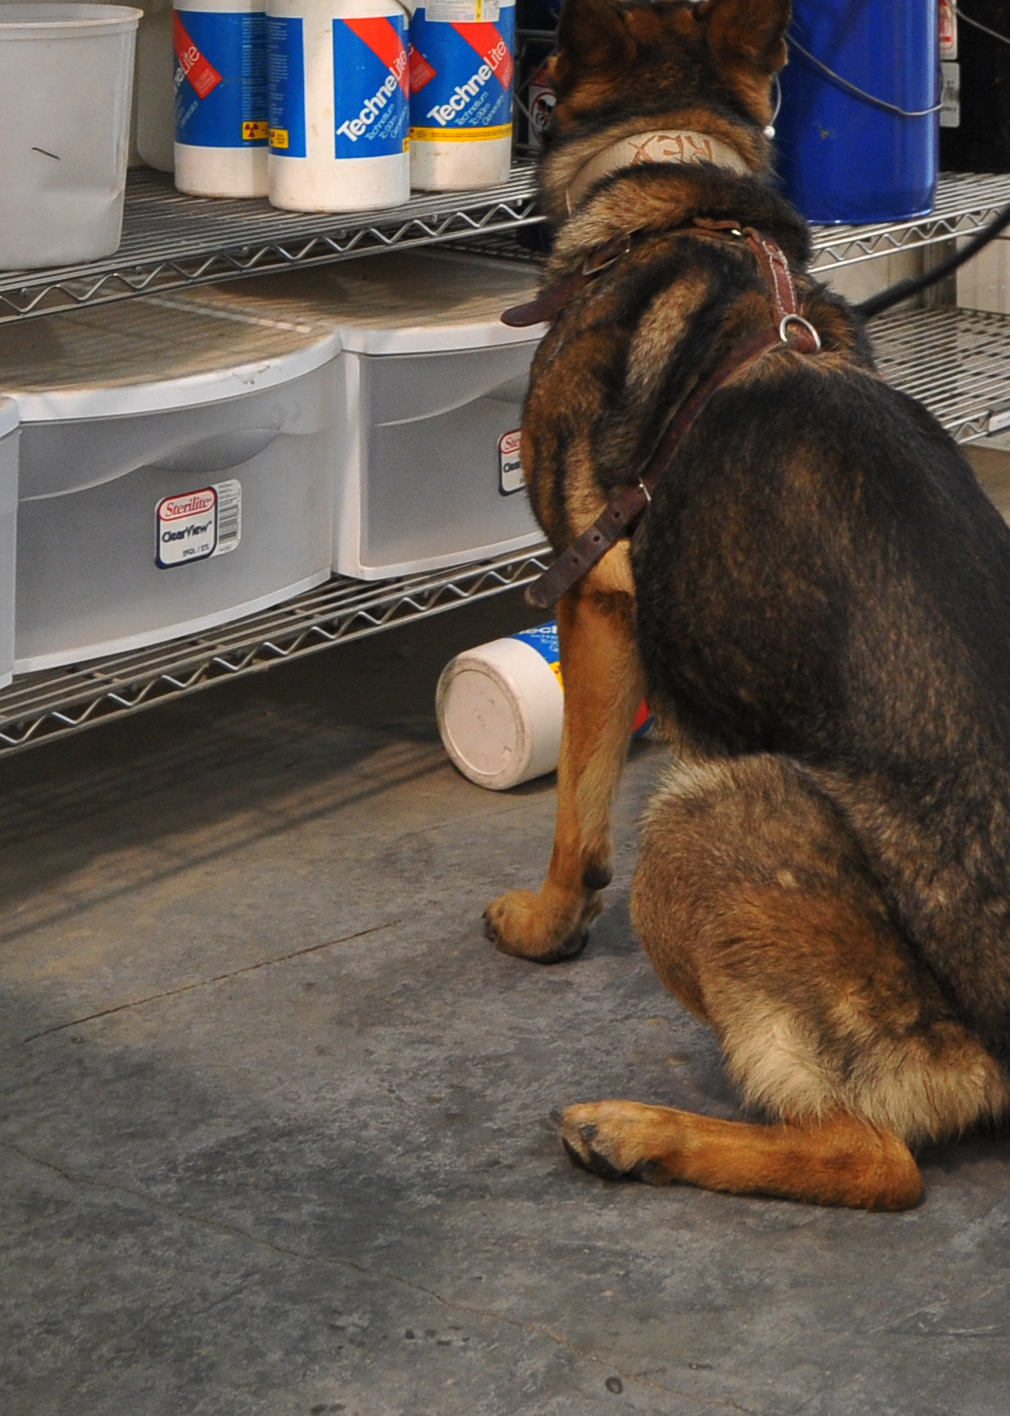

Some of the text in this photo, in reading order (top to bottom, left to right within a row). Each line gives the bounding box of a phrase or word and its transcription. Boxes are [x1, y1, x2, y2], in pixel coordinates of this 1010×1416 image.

[336, 50, 407, 143] TechneLite
[427, 40, 507, 127] TechneLite
[162, 523, 209, 543] ClearView
[165, 495, 207, 517] Sterilite
